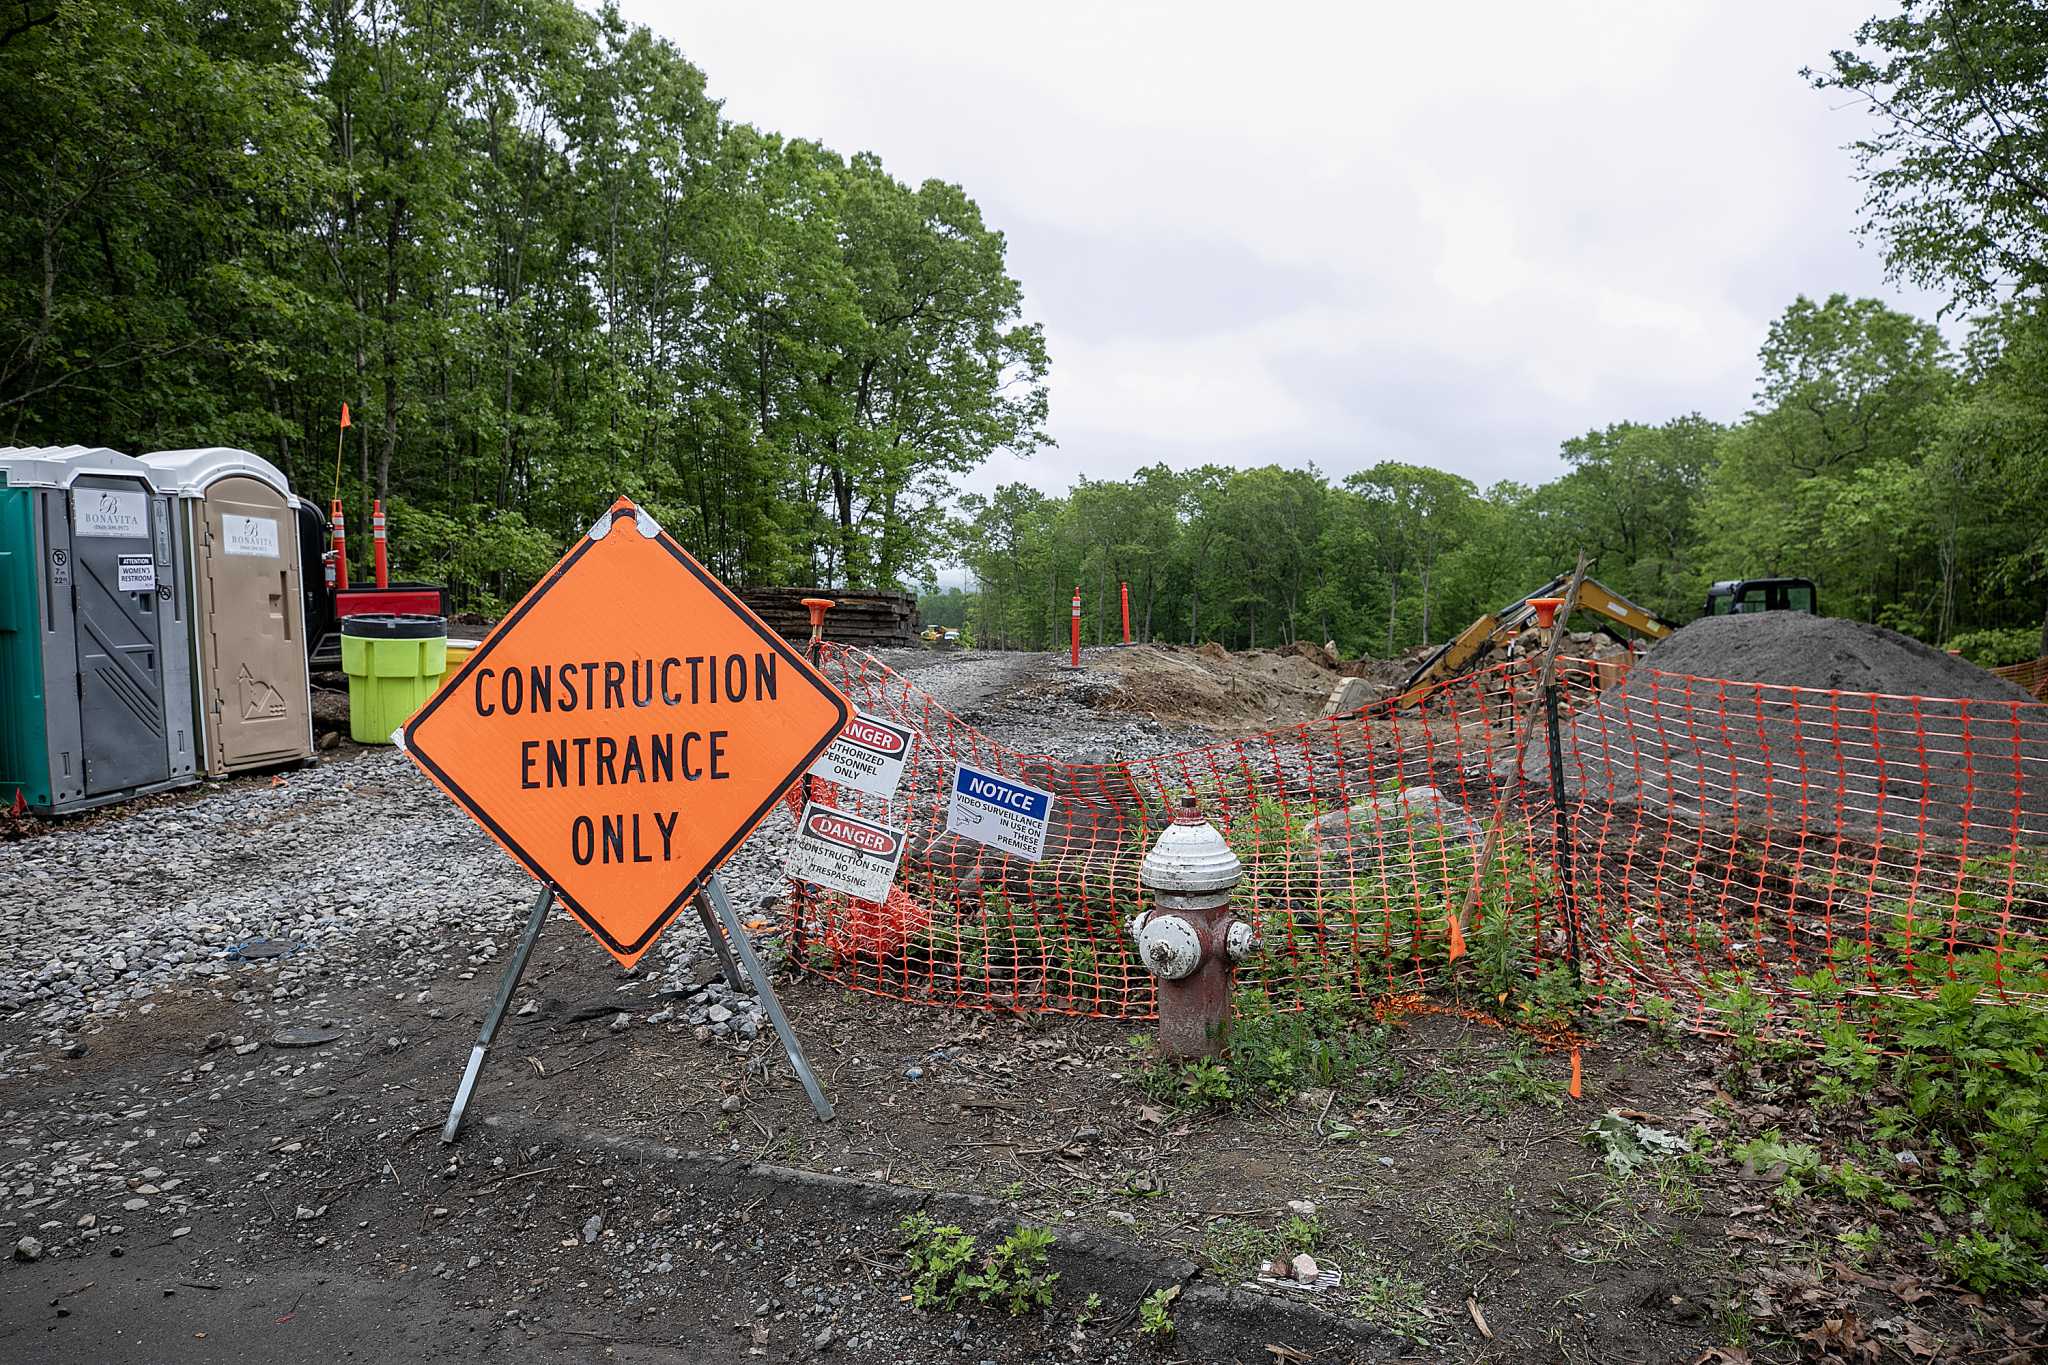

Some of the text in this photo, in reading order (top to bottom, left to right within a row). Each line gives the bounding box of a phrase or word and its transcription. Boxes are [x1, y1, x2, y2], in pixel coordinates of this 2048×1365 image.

[85, 512, 138, 525] BONAVITA
[122, 567, 151, 575] WOMEN'S
[475, 652, 778, 718] CONSTRUCTION
[844, 723, 893, 749] NGER
[520, 730, 730, 790] ENTRANCE
[822, 750, 878, 776] PERSONNEL
[829, 742, 885, 766] UTHORIZED
[833, 765, 860, 780] ONLY
[969, 777, 1035, 811] NOTICE
[956, 794, 1043, 830] VIDEO SURVEILLANCE
[571, 811, 680, 866] ONLY
[819, 818, 885, 851] DANGER
[999, 818, 1041, 838] IN USE ON
[1013, 831, 1039, 846] THESE
[997, 834, 1037, 854] PREMISES
[798, 841, 892, 877] CONSTRUCTION SITE
[834, 862, 848, 872] NO
[811, 864, 867, 888] TRESPASSING
